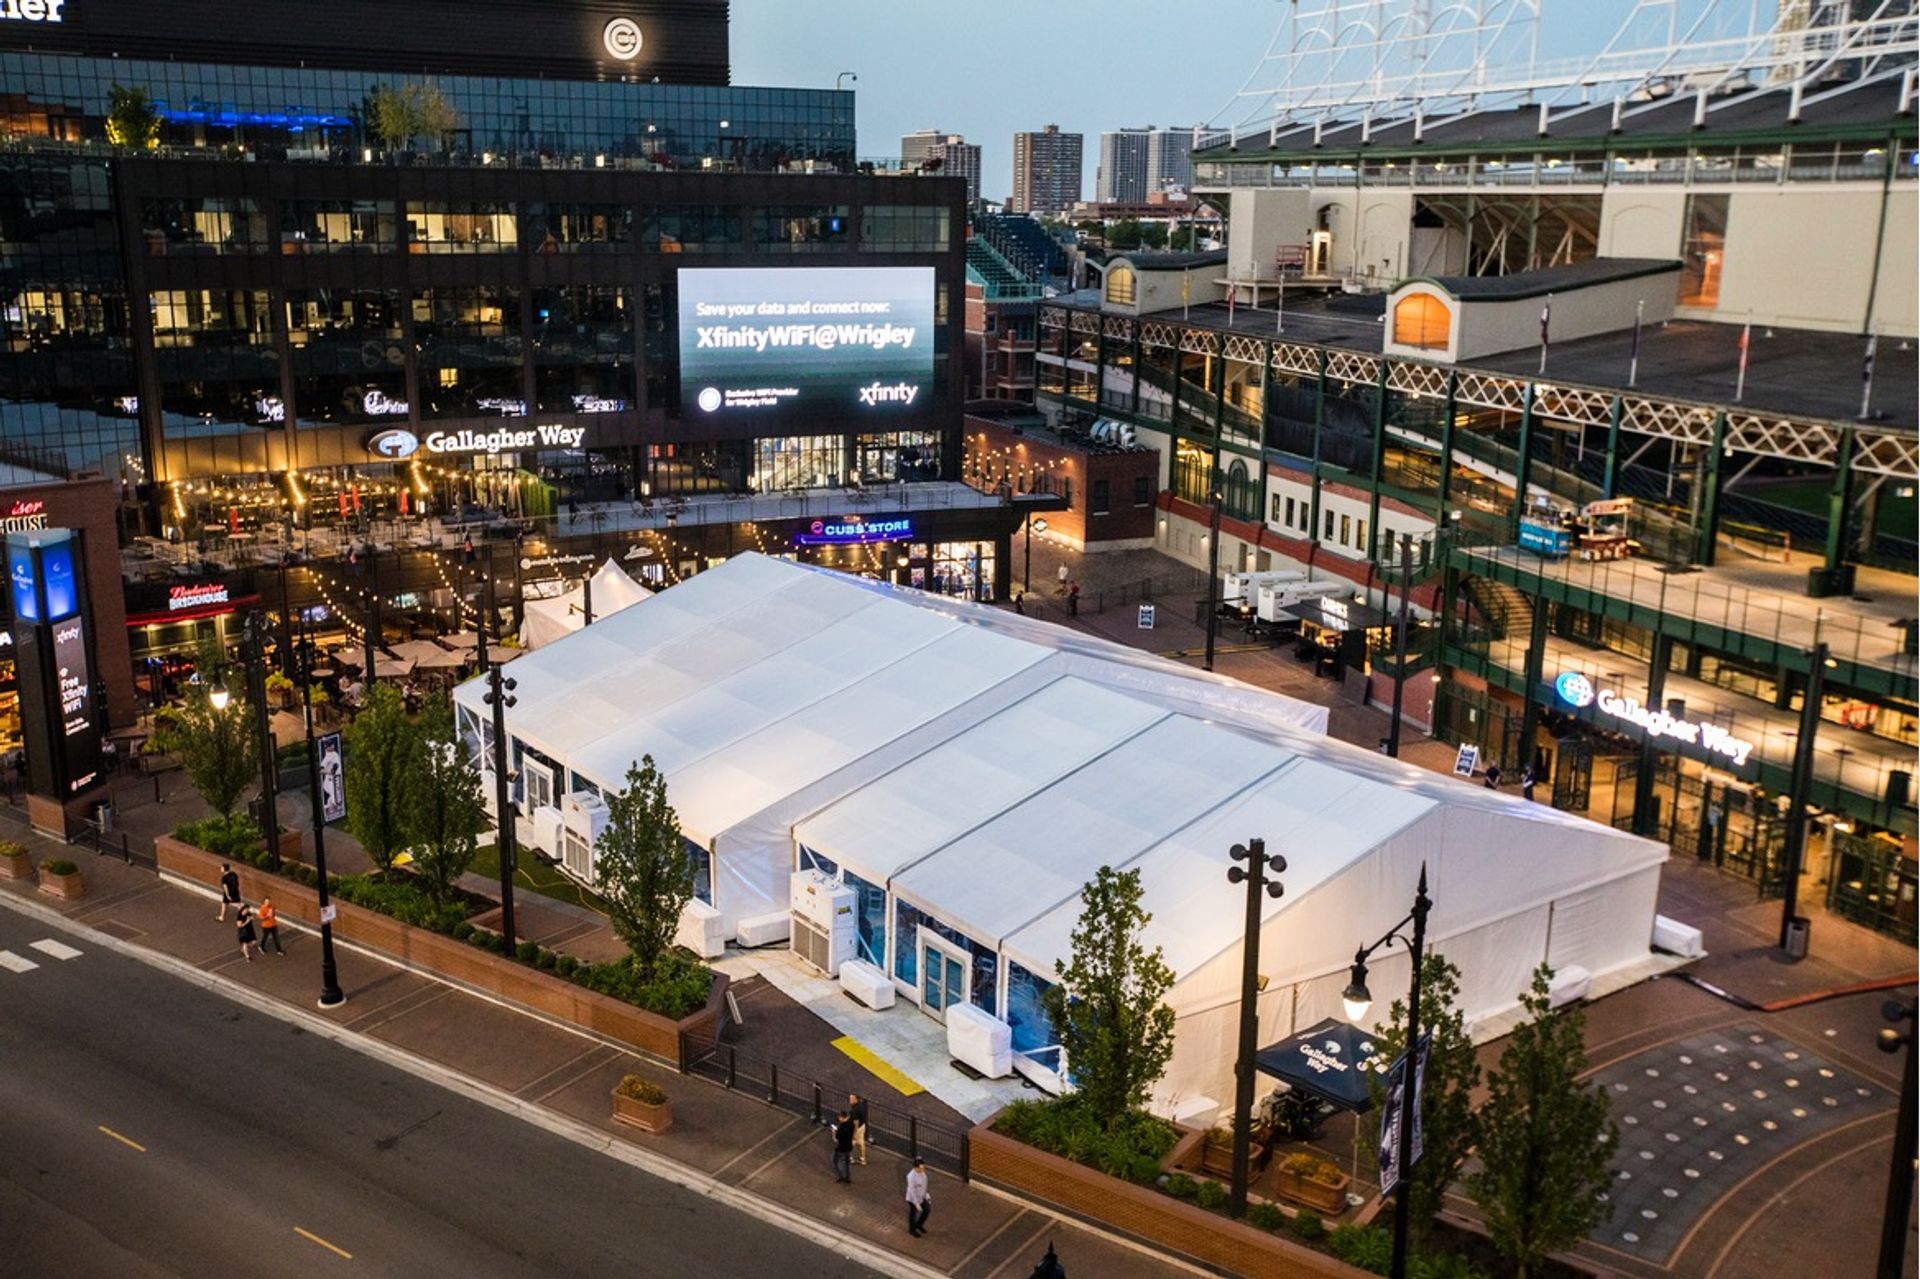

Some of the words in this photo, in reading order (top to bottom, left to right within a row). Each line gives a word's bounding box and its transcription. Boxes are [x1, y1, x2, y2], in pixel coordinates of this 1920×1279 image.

[696, 302, 726, 316] Save
[728, 303, 756, 318] your
[758, 301, 785, 315] data
[788, 301, 811, 314] and
[813, 302, 859, 314] connect
[862, 302, 890, 314] now:
[697, 324, 915, 351] XfinityWiFi@Wrigley
[859, 382, 918, 406] xfinity
[426, 427, 536, 452] Gallagher
[538, 424, 585, 446] Way
[825, 524, 865, 535] CUBS
[869, 520, 909, 533] STORE
[61, 677, 79, 690] Free
[1598, 690, 1698, 743] Gallagher
[1699, 722, 1753, 766] Way
[1300, 1043, 1349, 1072] Gallagher
[1306, 1057, 1329, 1073] Way
